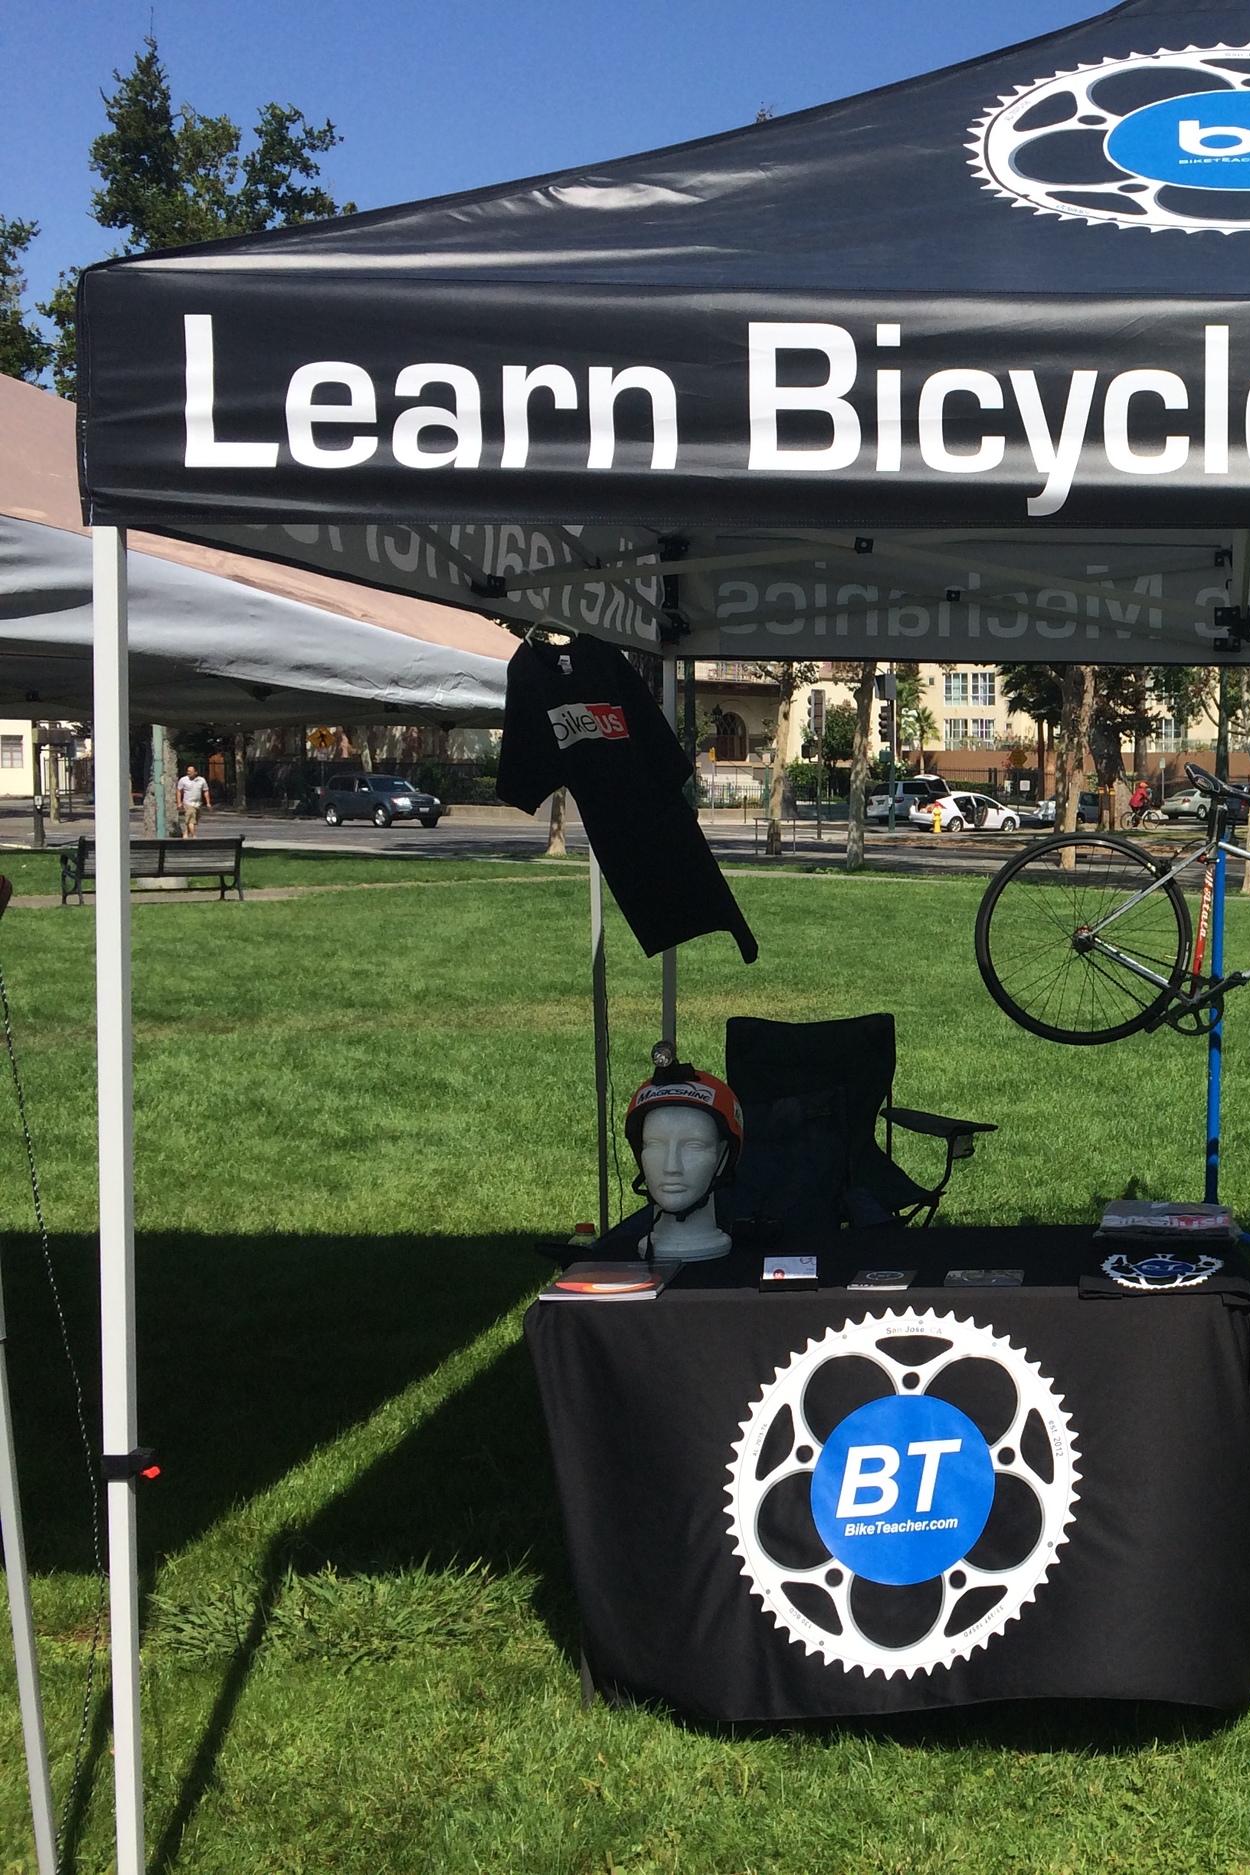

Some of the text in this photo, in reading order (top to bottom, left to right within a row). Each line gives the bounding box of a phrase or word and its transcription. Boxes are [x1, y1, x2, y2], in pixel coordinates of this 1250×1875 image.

[182, 313, 677, 470] Learn
[638, 1088, 712, 1104] MAGICSHINE
[1053, 1436, 1064, 1457] 2012
[835, 1438, 962, 1519] BT
[844, 1518, 959, 1537] BikeTeacher.com
